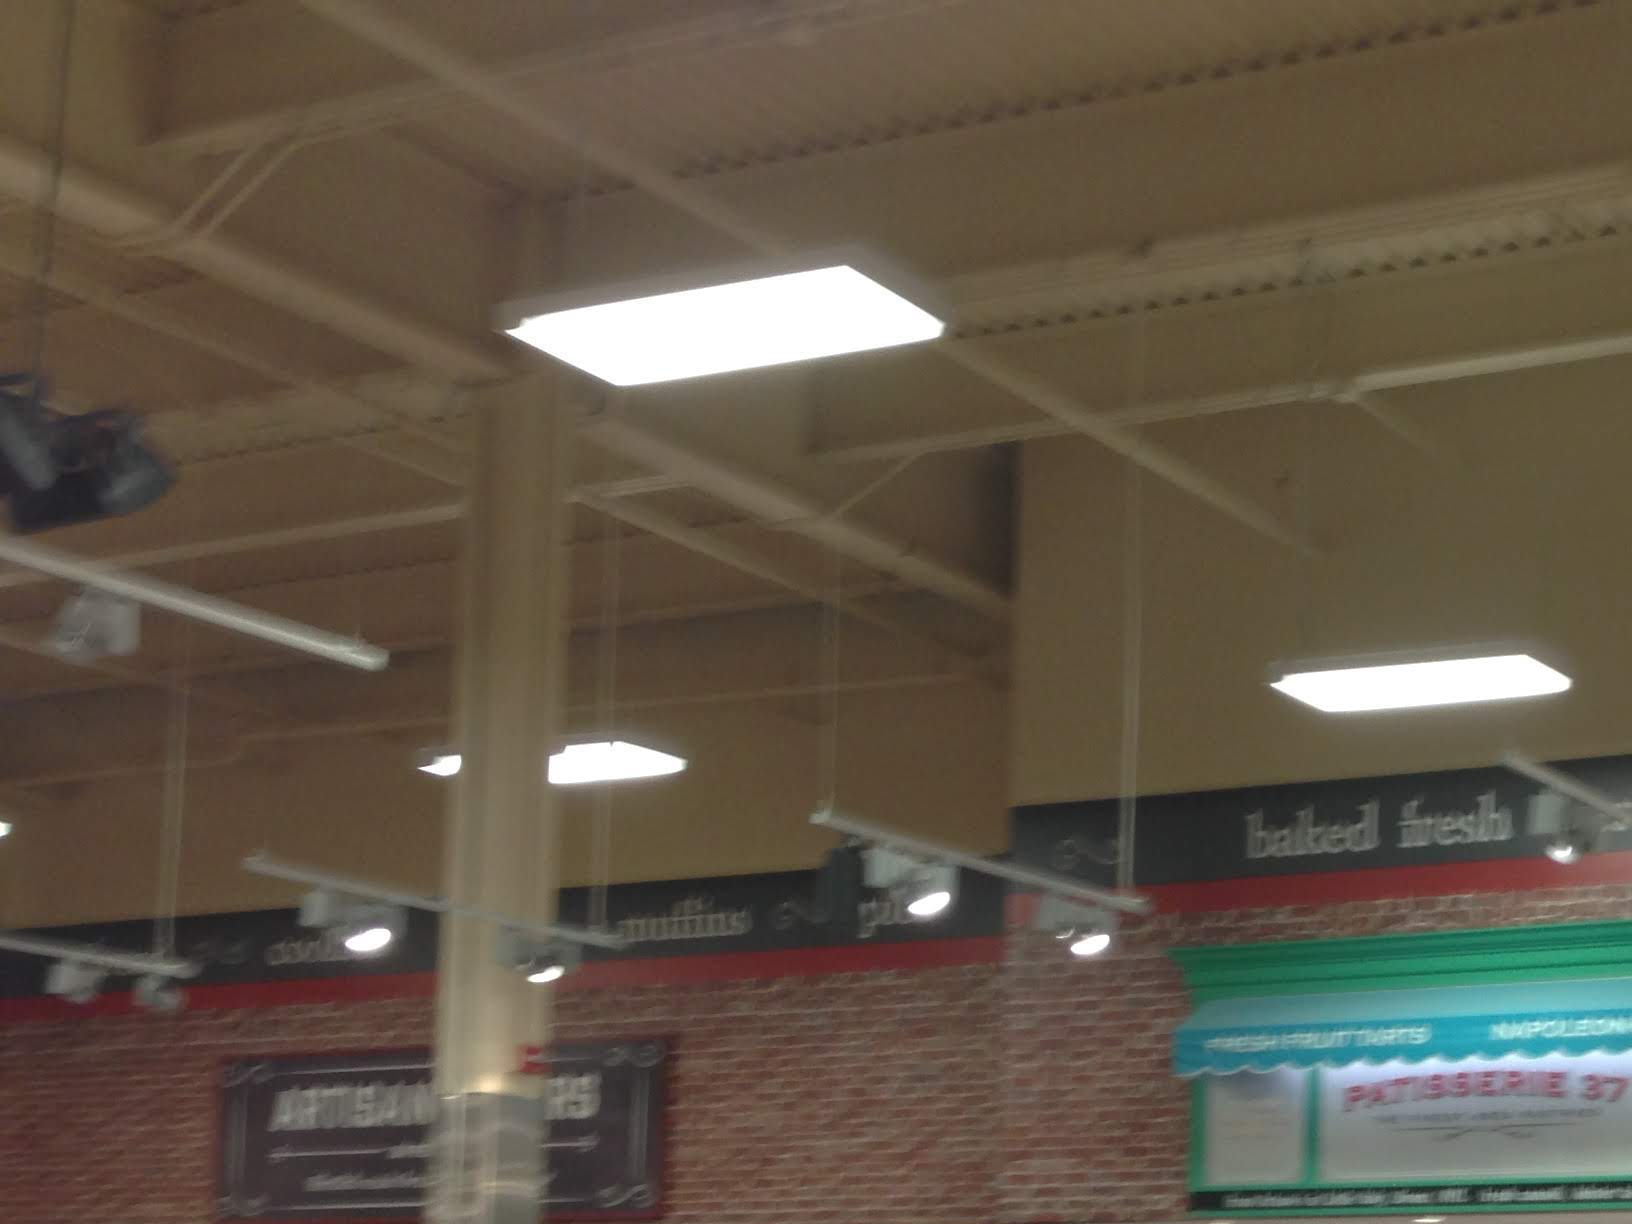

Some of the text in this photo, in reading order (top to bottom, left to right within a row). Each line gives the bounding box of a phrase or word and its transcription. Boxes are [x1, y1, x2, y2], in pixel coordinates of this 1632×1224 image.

[1246, 800, 1380, 859] baked
[1397, 790, 1513, 848] fresh
[1342, 1069, 1632, 1114] PATISSERIE 37
